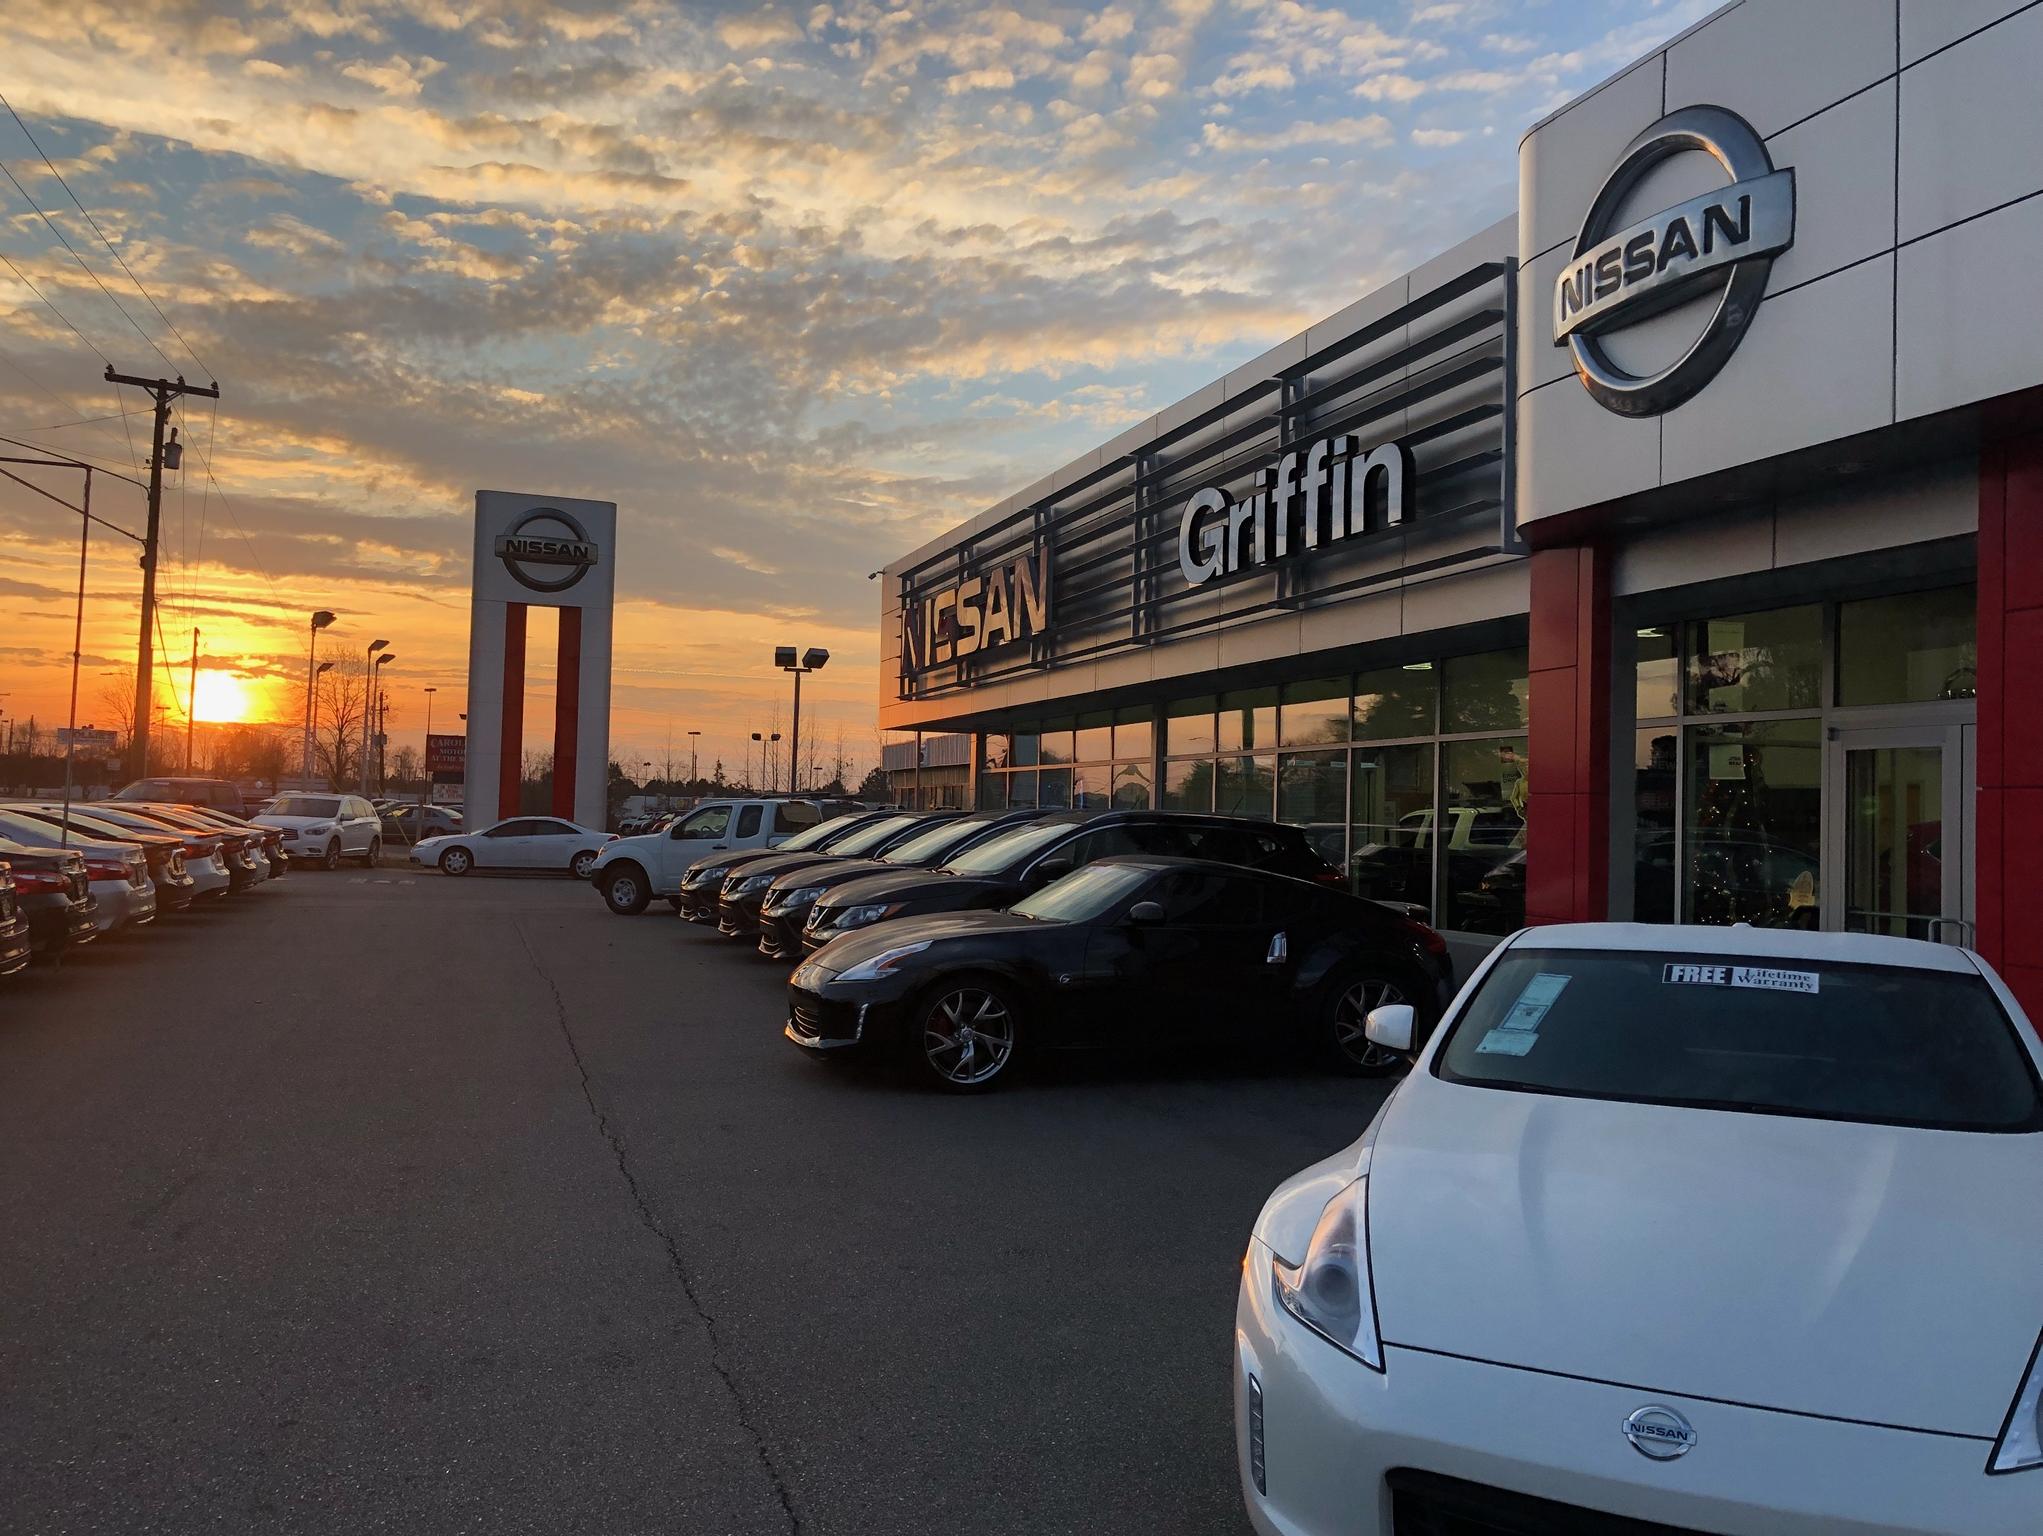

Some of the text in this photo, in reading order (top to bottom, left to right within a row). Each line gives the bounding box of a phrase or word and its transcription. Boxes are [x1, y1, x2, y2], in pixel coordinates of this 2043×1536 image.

[1560, 194, 1752, 322] NISSAN
[1179, 435, 1413, 585] Griffin
[505, 539, 589, 560] NISSAN
[901, 545, 1050, 671] NISSAN
[1670, 965, 1727, 984] FREE
[1738, 975, 1814, 991] Warranty
[1744, 968, 1812, 982] Lifetime
[1630, 1423, 1688, 1441] NISSAN
